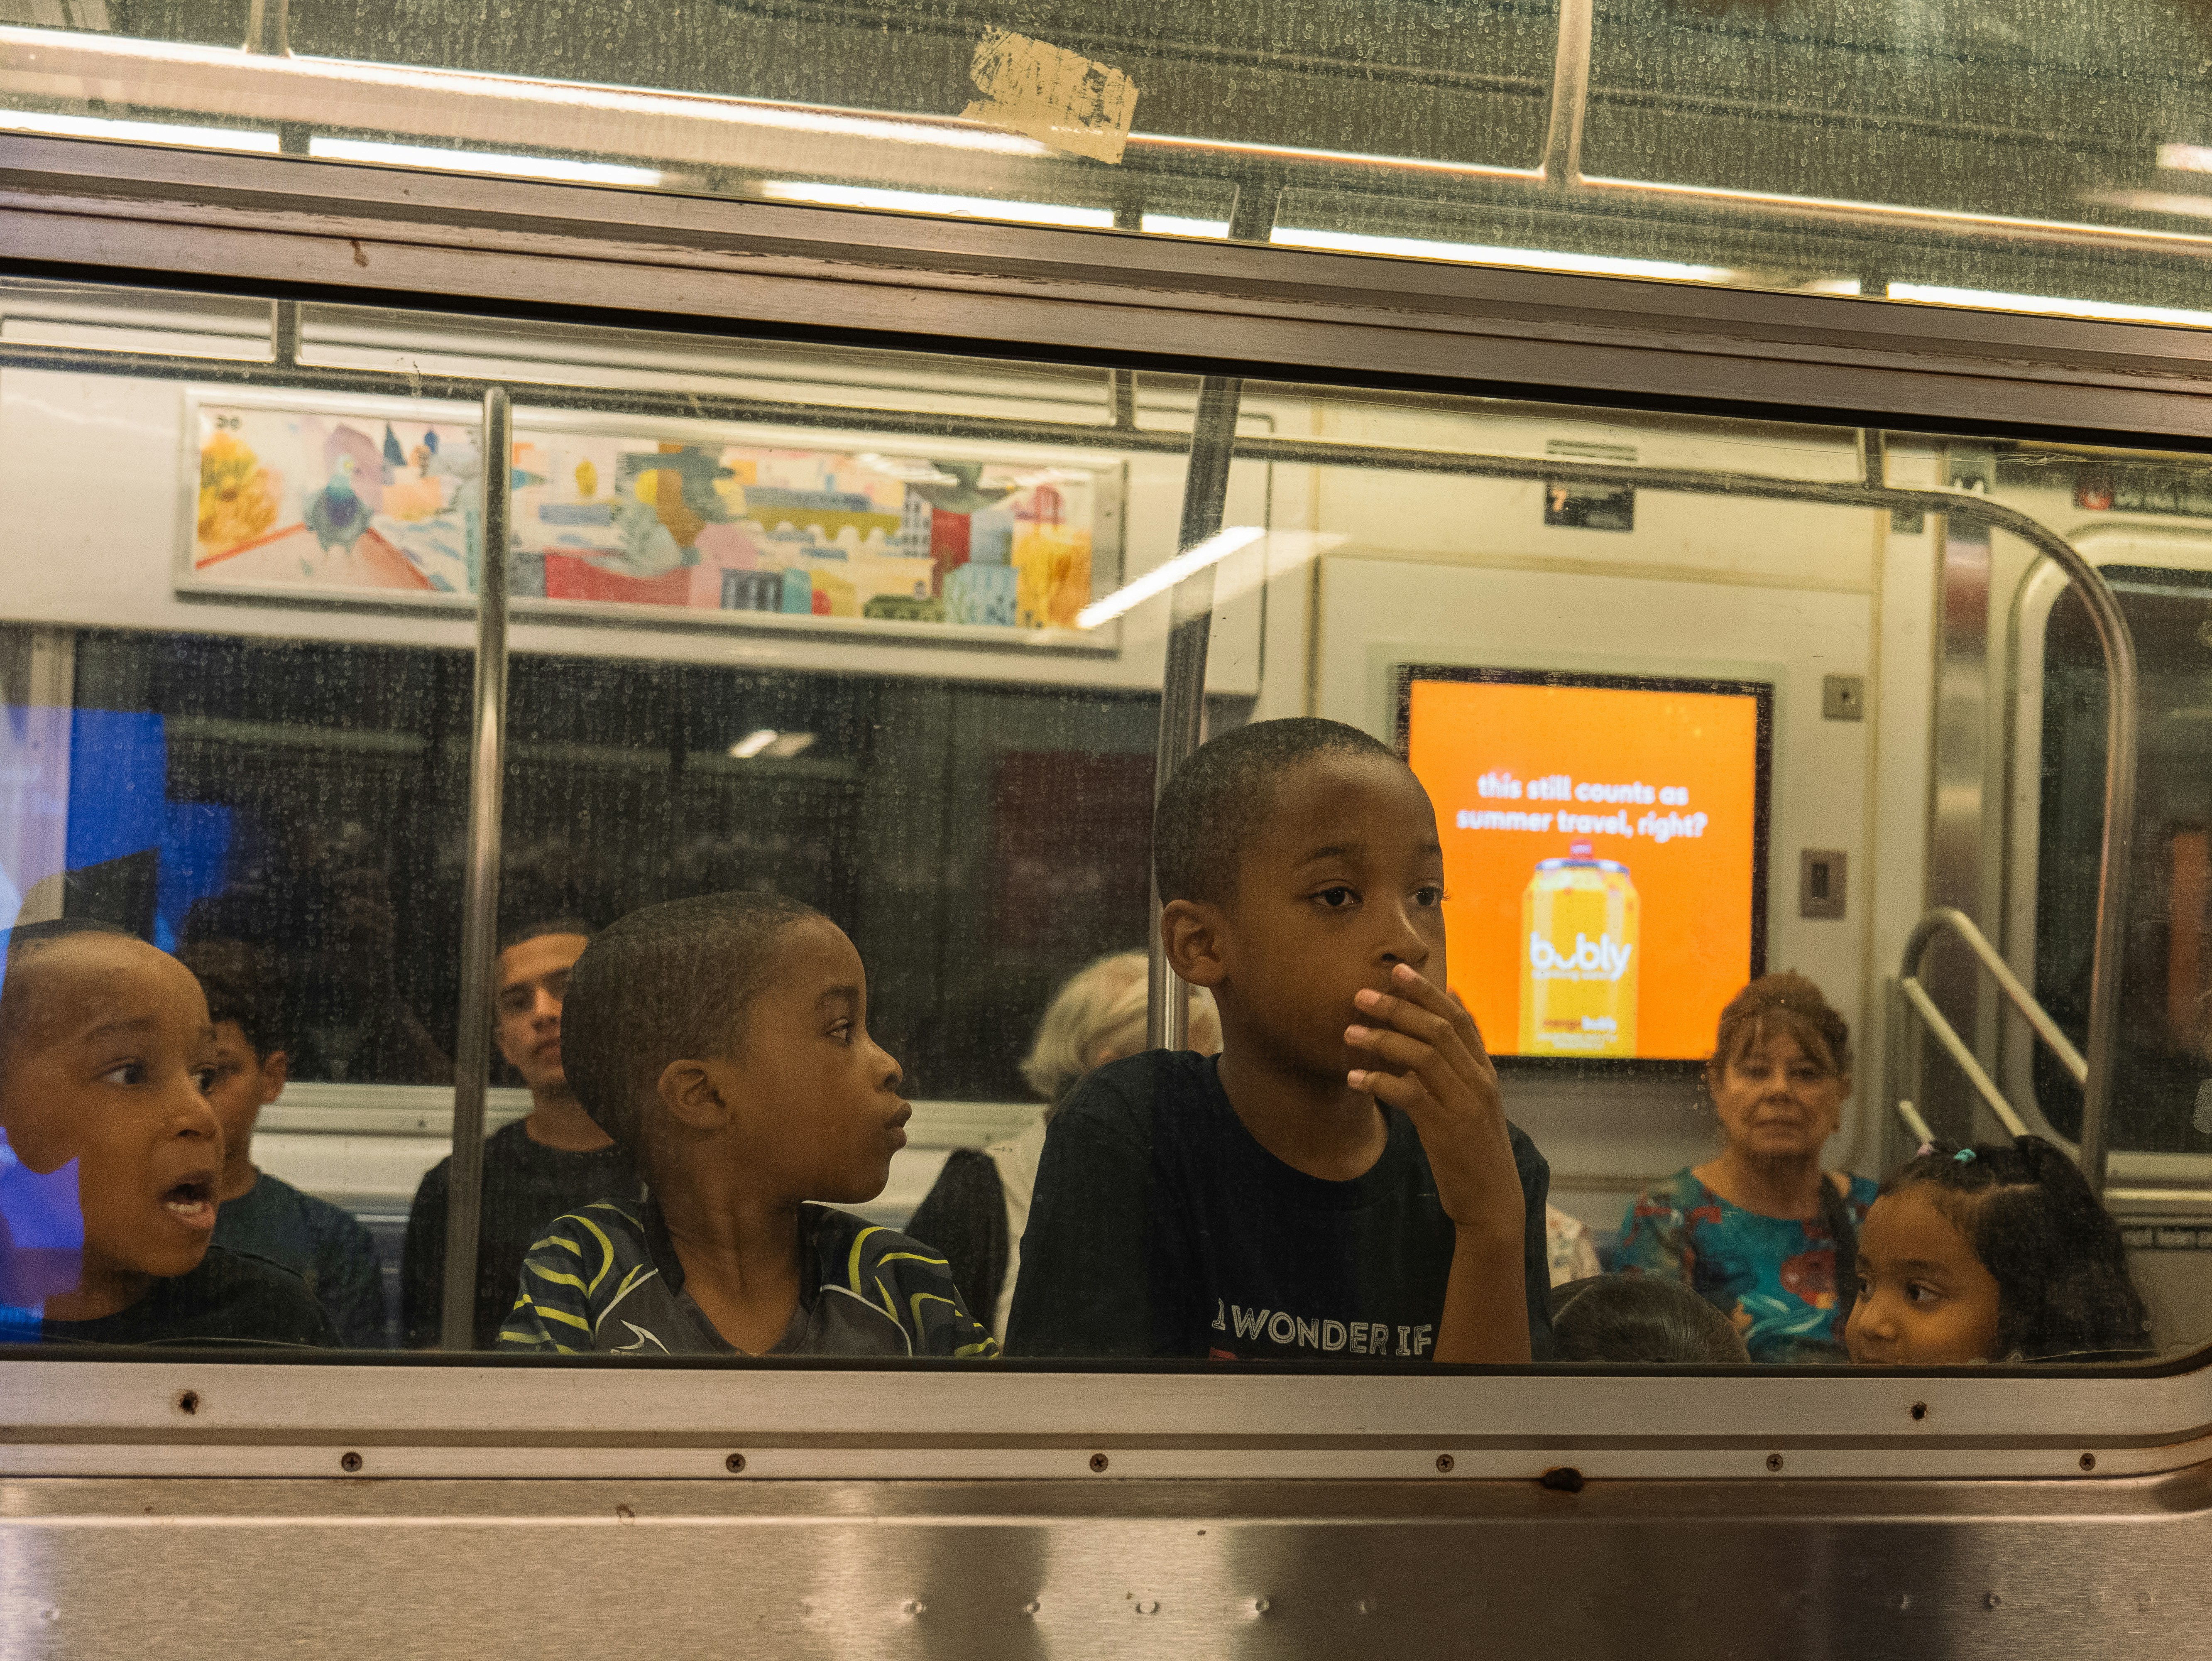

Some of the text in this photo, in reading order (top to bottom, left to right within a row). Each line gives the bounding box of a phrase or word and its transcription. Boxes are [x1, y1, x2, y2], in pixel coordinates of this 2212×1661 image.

[1552, 490, 1566, 512] 7
[1477, 771, 1688, 806] this still counts as
[1457, 809, 1708, 843] summer travel, right?
[1212, 1298, 1226, 1330] I
[1231, 1305, 1389, 1355] WONDER
[1396, 1324, 1432, 1356] IF
